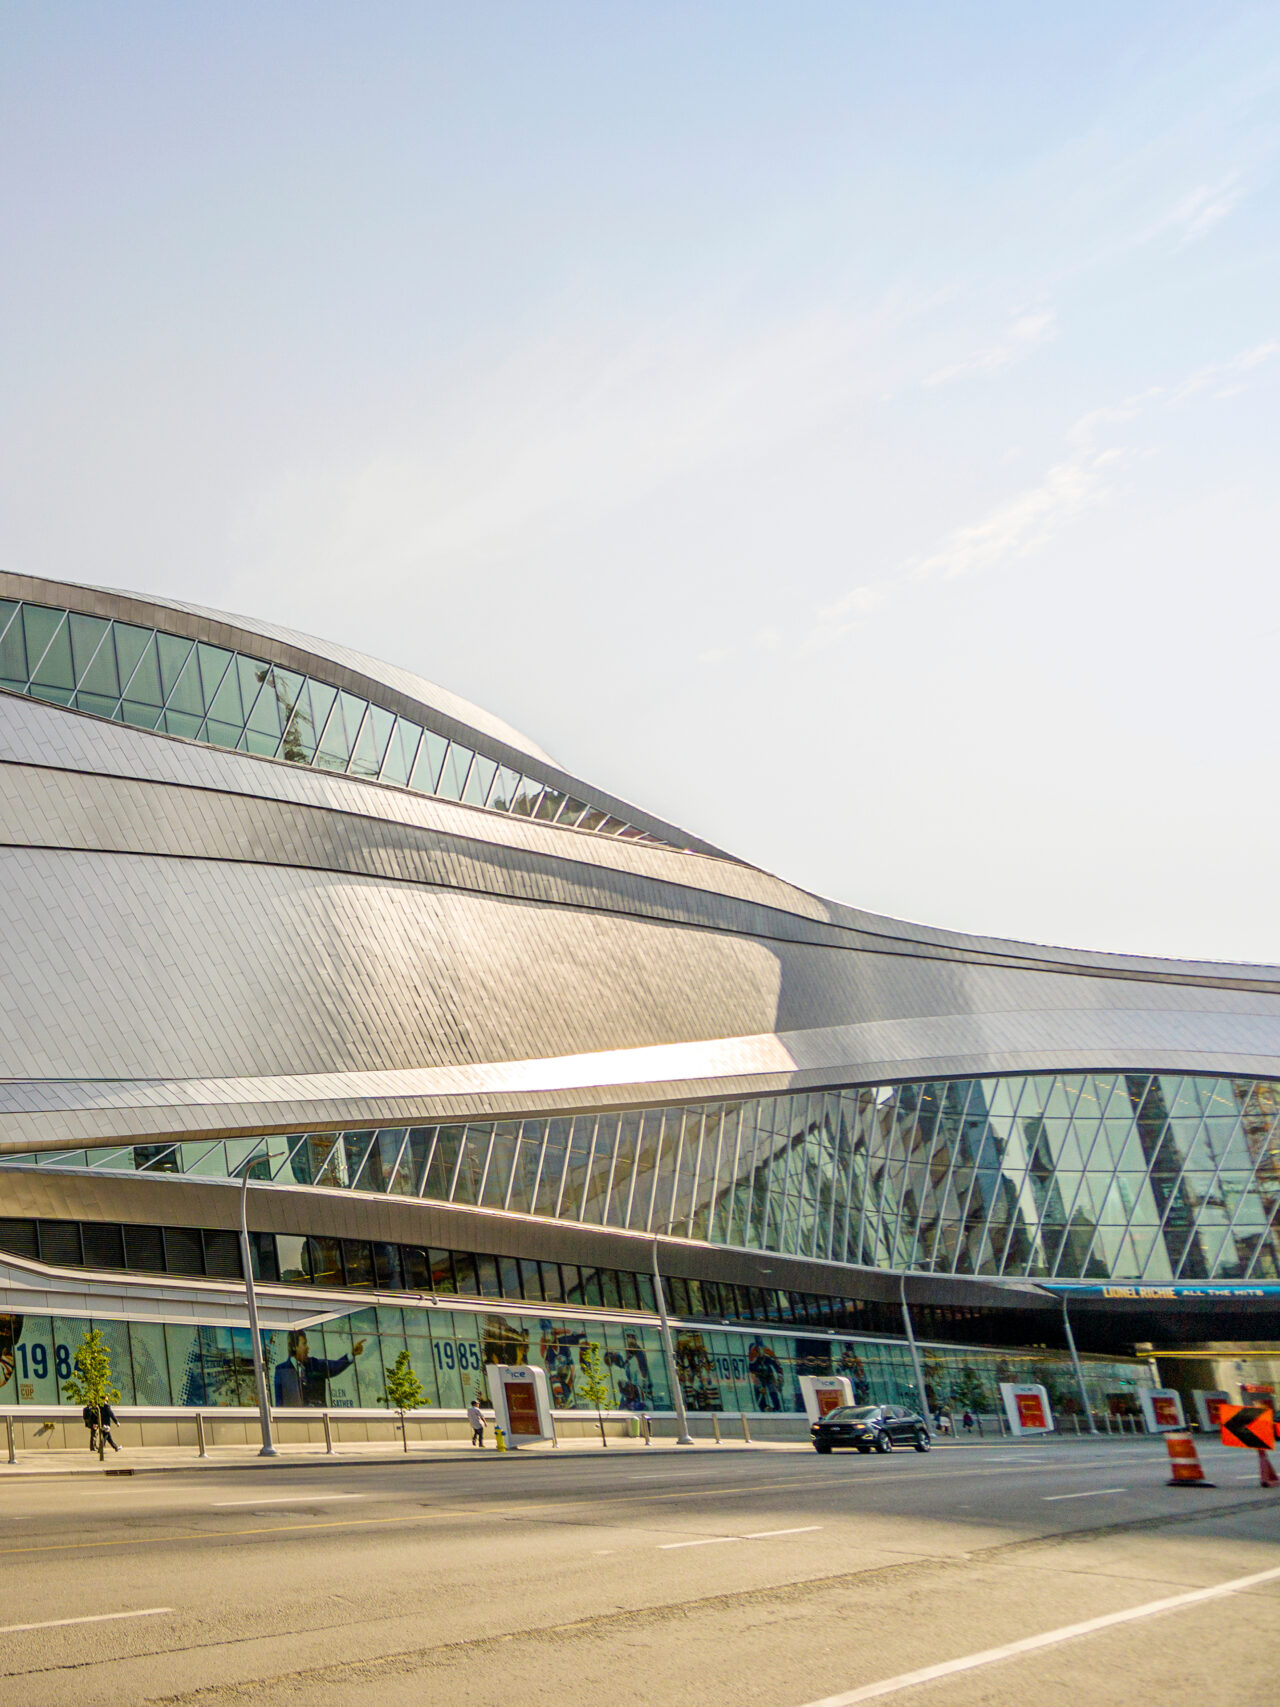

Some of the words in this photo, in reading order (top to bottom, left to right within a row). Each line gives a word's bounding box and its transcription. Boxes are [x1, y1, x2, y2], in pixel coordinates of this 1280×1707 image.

[1103, 1287, 1138, 1298] LIONEL
[1139, 1287, 1178, 1299] RICHIE
[434, 1341, 480, 1371] 1985
[716, 1357, 746, 1381] 1987
